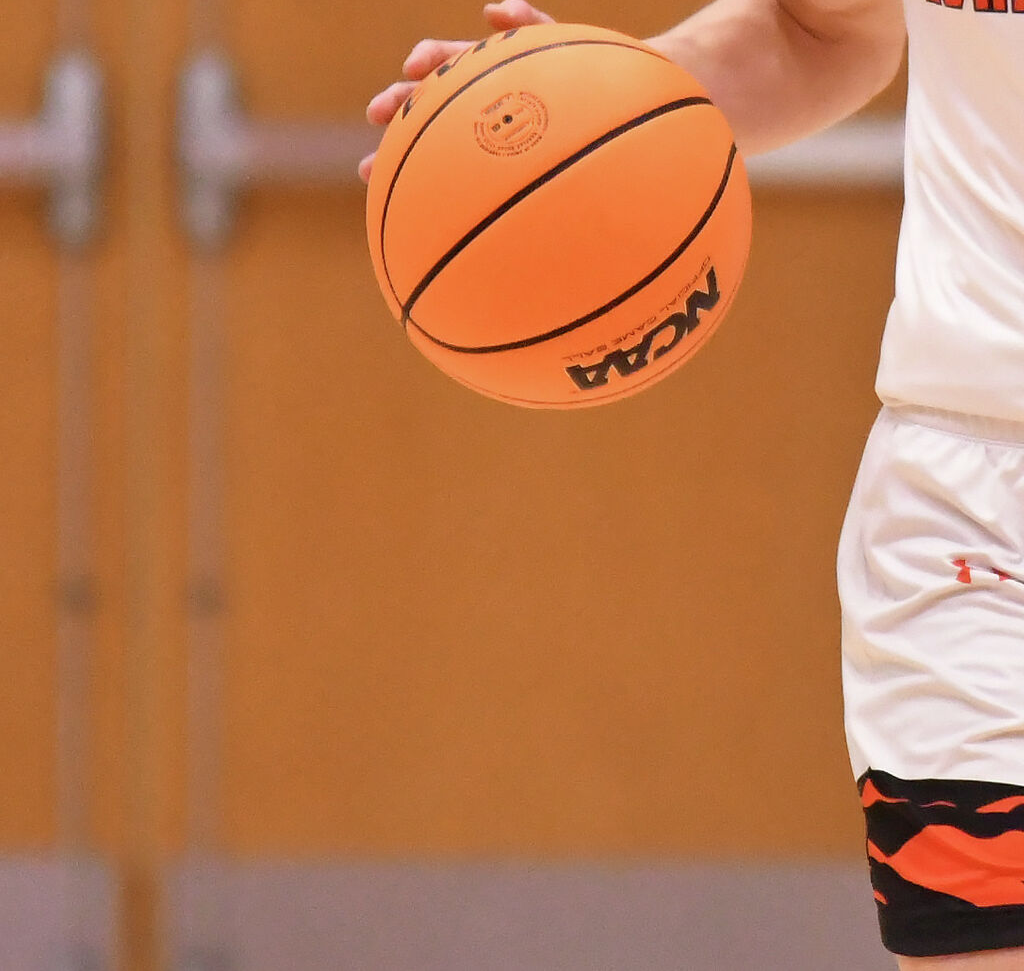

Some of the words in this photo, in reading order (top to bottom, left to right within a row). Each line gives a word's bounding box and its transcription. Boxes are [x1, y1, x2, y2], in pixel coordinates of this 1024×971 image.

[659, 255, 711, 312] OFFICIAL
[564, 264, 721, 391] NCAA
[613, 316, 658, 345] GAME
[562, 345, 608, 362] BALL
